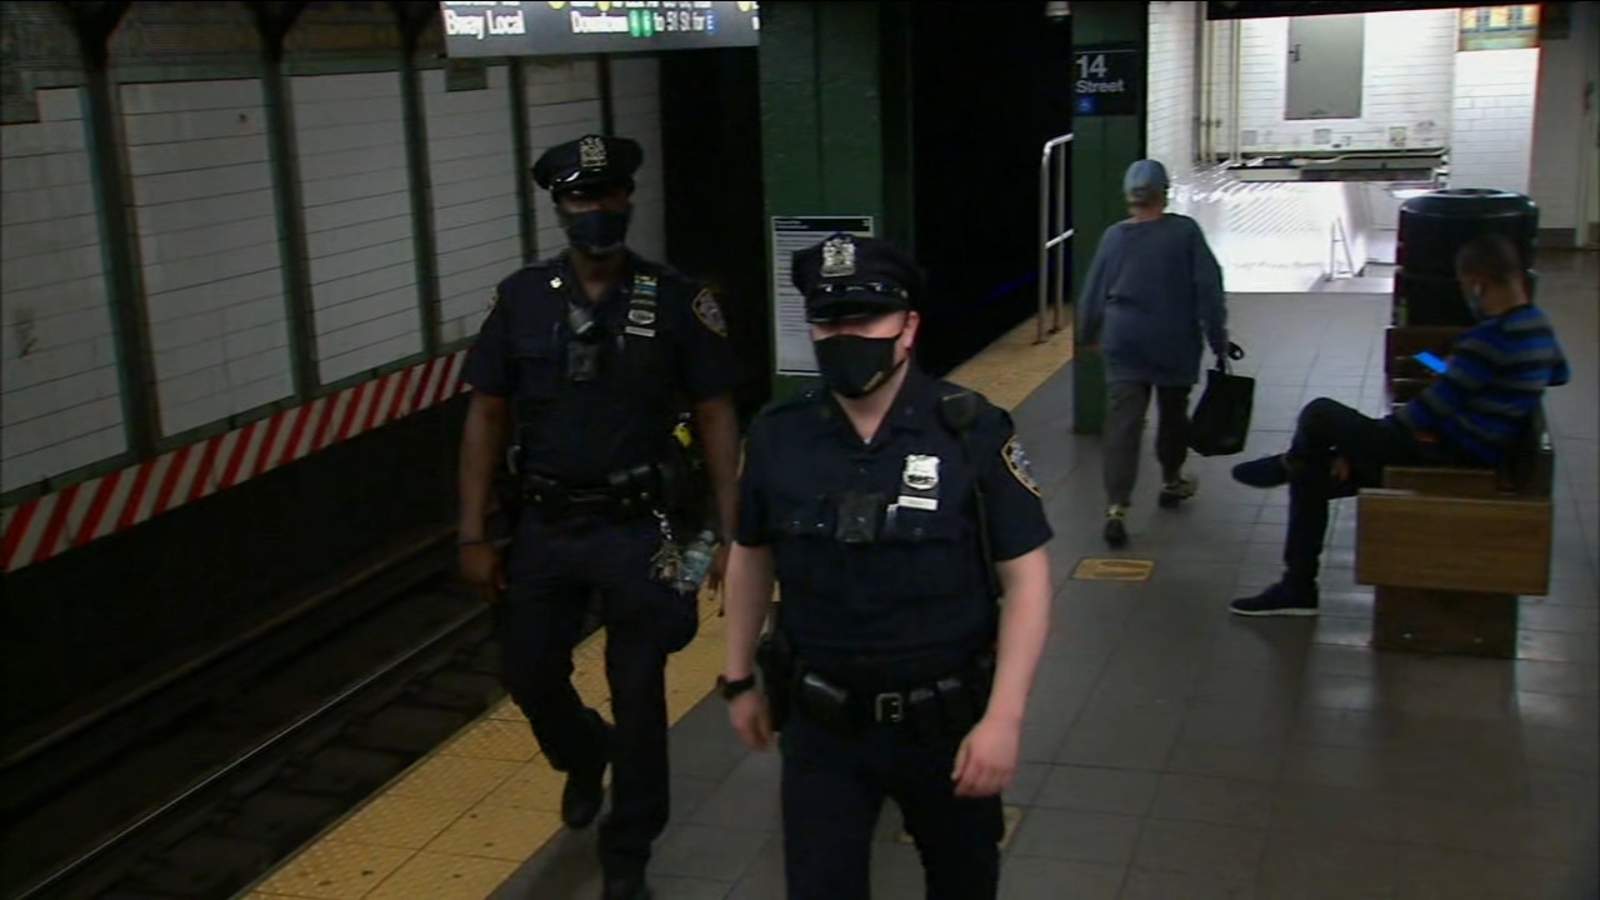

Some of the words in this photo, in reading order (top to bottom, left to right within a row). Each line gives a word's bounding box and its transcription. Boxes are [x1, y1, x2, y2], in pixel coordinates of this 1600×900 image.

[486, 9, 526, 34] Local
[653, 12, 665, 31] to
[1076, 54, 1108, 78] 14
[1076, 79, 1125, 93] Street
